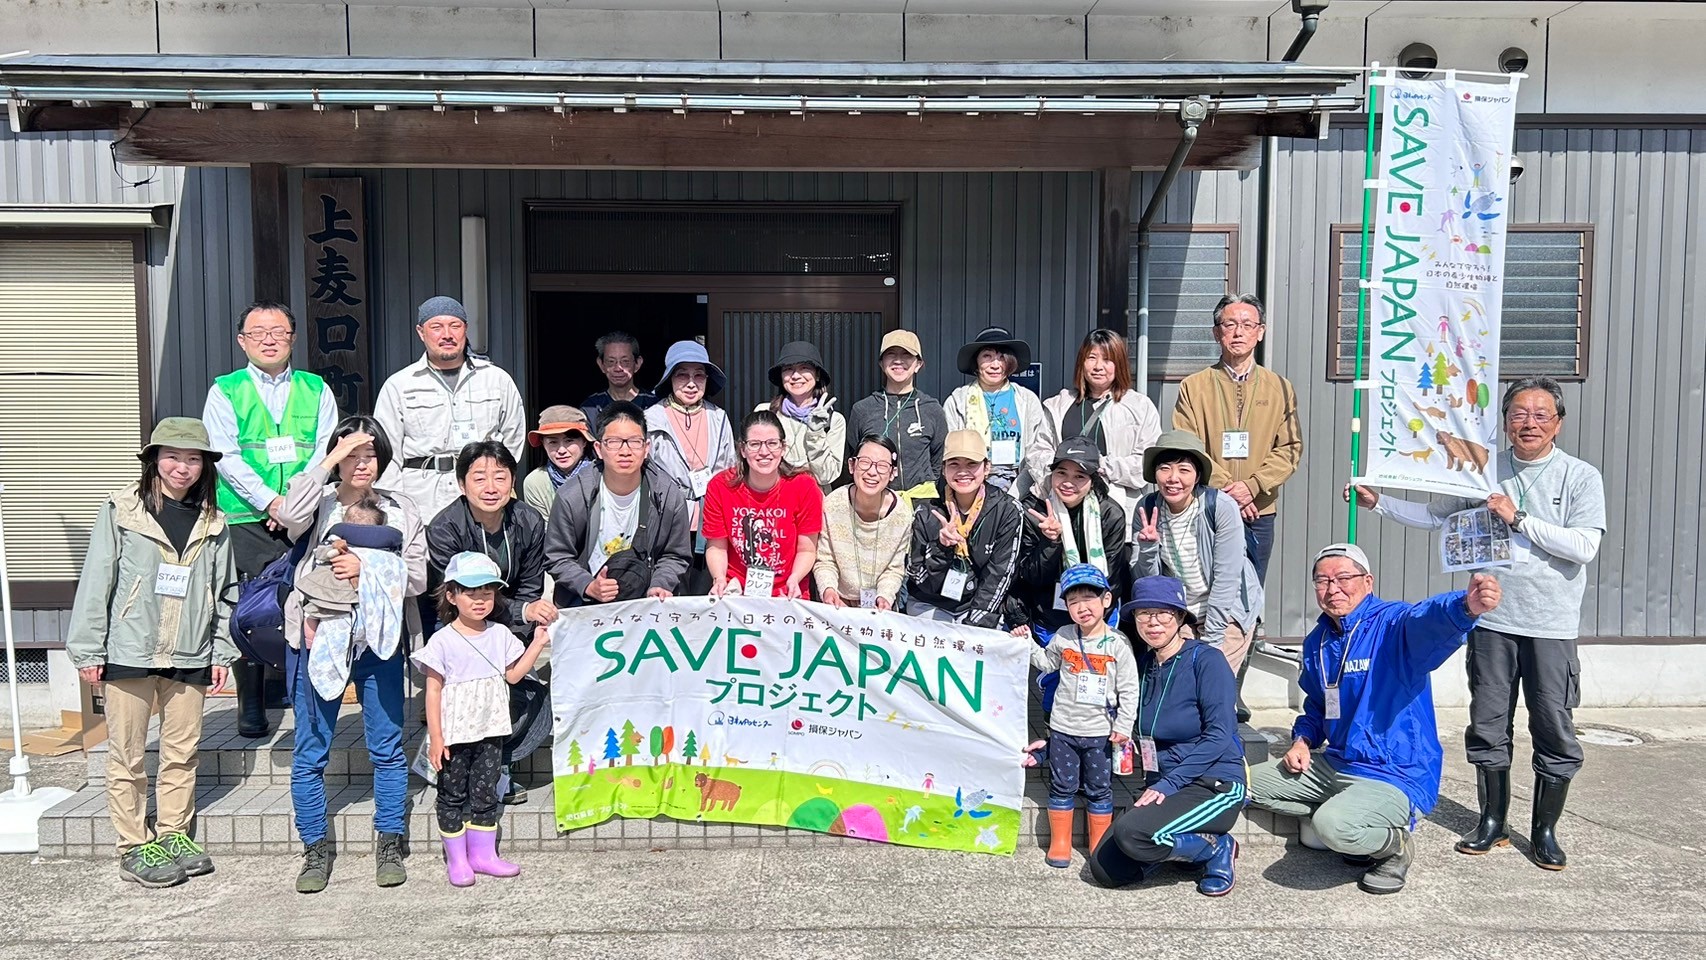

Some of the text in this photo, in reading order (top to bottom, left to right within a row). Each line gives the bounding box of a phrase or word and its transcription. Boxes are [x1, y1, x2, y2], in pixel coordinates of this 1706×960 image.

[1379, 104, 1429, 458] SAVE JAPAN プロジェクト
[267, 443, 295, 454] STAFF
[732, 507, 787, 518] YOSAKOI
[731, 527, 786, 539] FEVAL
[158, 572, 188, 583] STAFF
[746, 581, 772, 590] クレア
[594, 626, 984, 713] SAVE JAPAN
[706, 677, 878, 721] プロジェクト
[808, 724, 863, 740] 損保ジャパン
